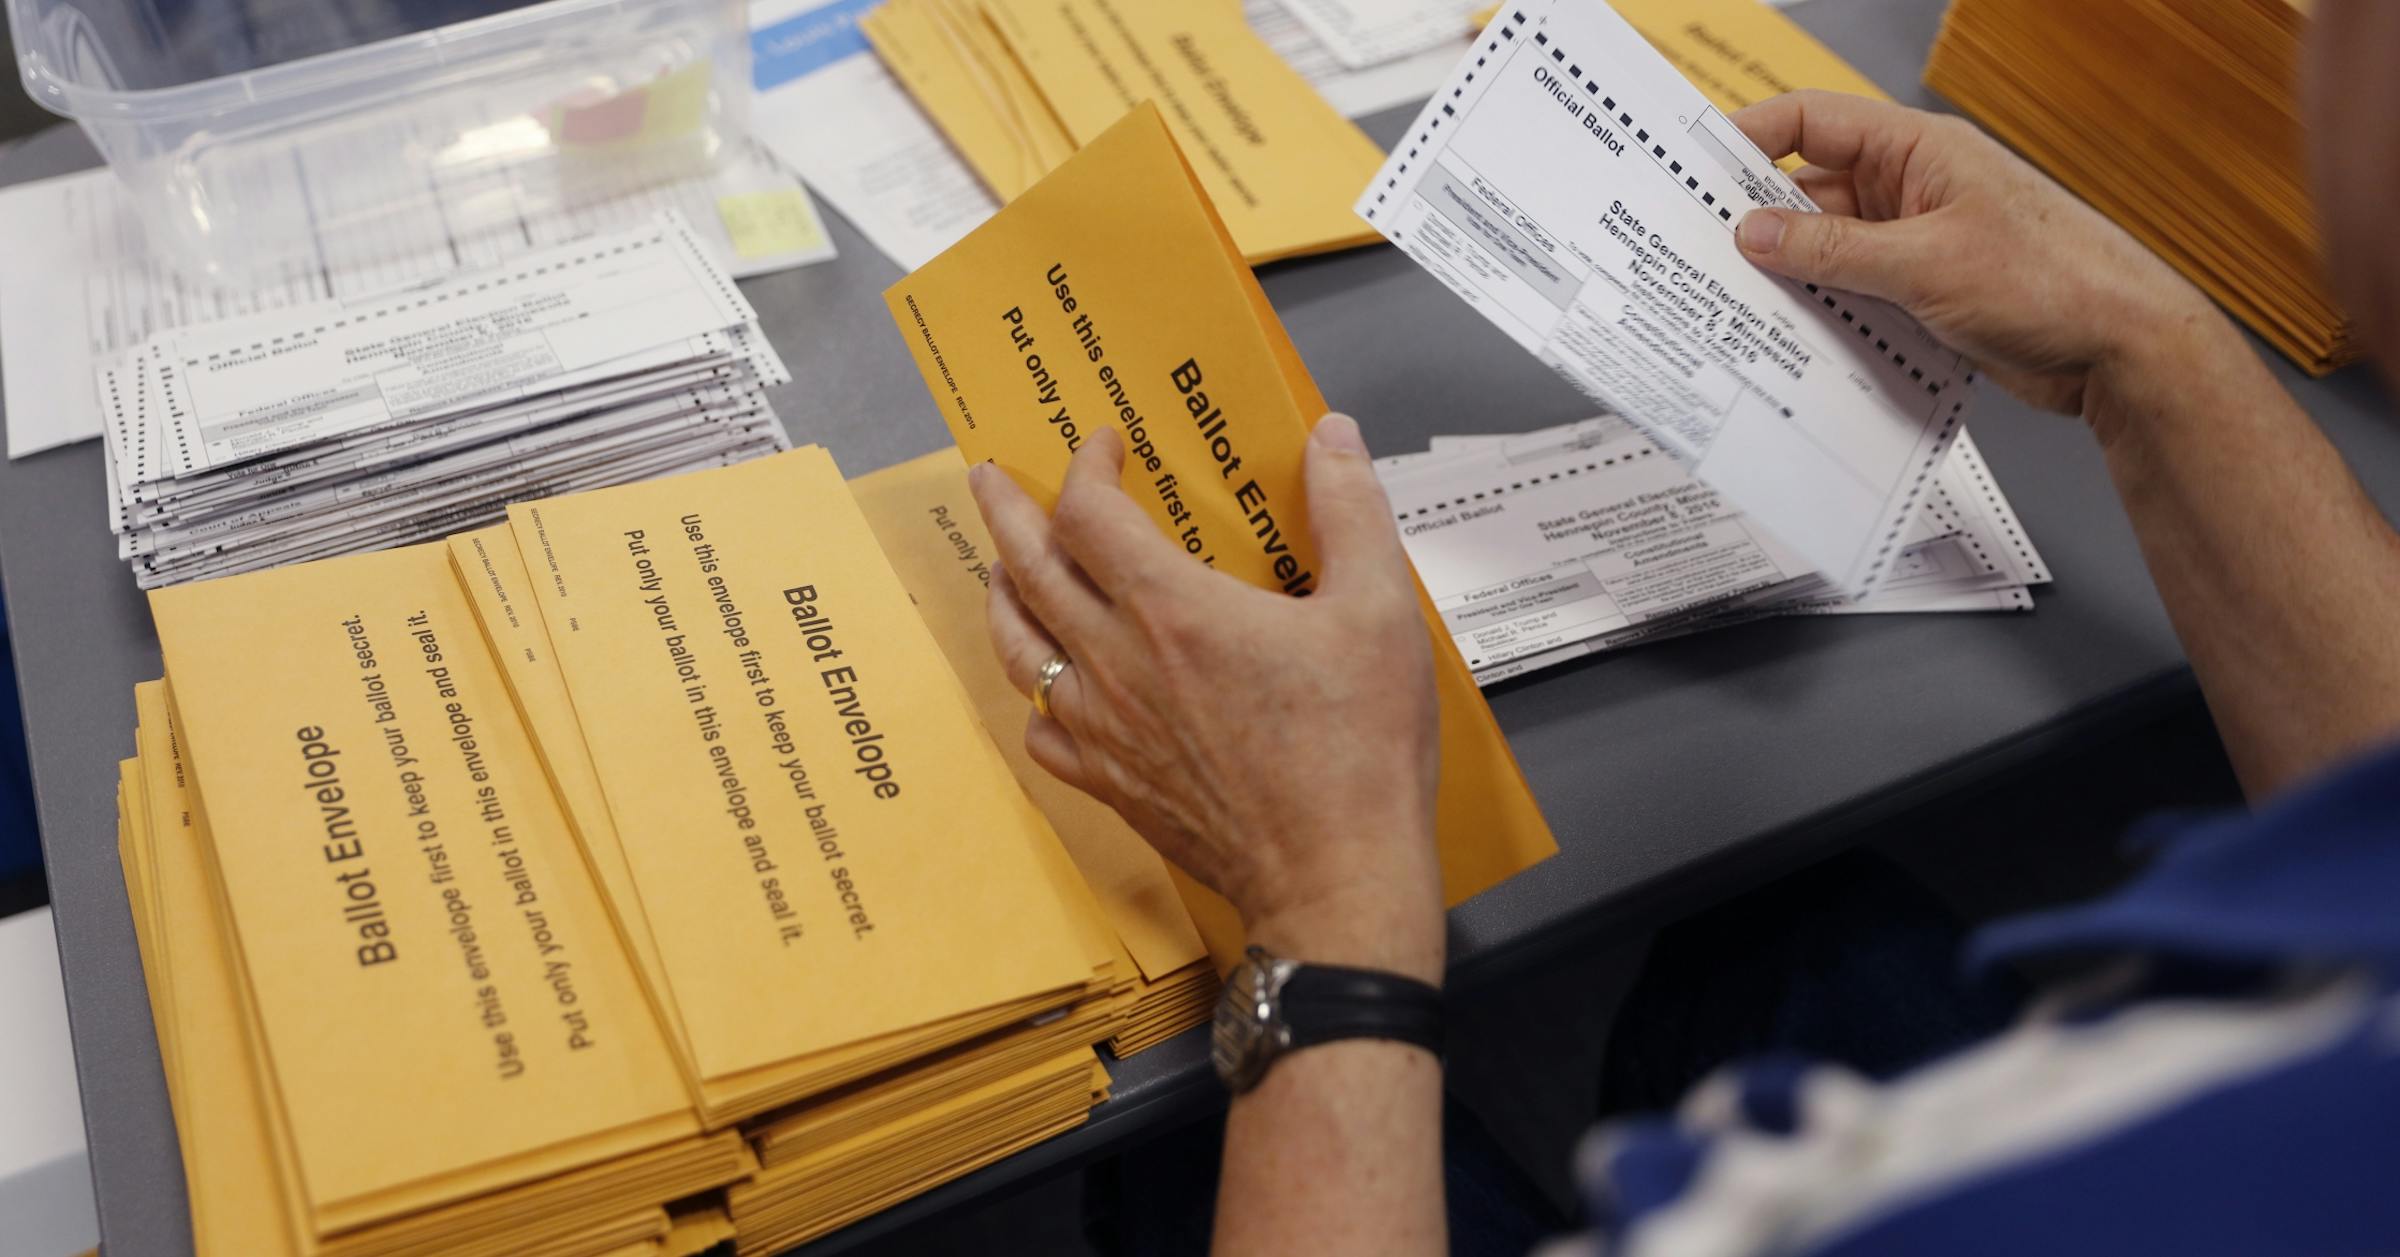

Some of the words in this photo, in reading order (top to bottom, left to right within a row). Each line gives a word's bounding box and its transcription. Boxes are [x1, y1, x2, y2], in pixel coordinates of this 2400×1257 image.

[1533, 66, 1585, 118] Official
[1582, 112, 1625, 157] Ballot
[1742, 168, 1754, 182] One
[1746, 184, 1768, 206] Judge
[1764, 175, 1787, 201] Garcia
[1471, 177, 1515, 218] Federal
[1515, 215, 1555, 253] Offices
[1764, 189, 1776, 204] Vote
[1599, 213, 1666, 274] Hennepin
[1671, 272, 1723, 321] County,
[1729, 317, 1802, 378] Minnesota
[1610, 201, 1645, 236] State
[1649, 234, 1705, 283] General
[1706, 280, 1765, 330] Election
[1768, 327, 1810, 364] Ballot
[1629, 260, 1703, 320] November
[1722, 332, 1756, 363] 2016
[209, 351, 267, 372] Official
[271, 339, 318, 356] Ballot
[906, 295, 926, 327] SECRECY
[923, 328, 939, 355] BALLOT
[936, 355, 957, 393] ENVELOPE
[1001, 305, 1035, 353] Put
[1026, 354, 1062, 405] only
[1047, 406, 1081, 455] you
[1046, 262, 1078, 314] Use
[1072, 313, 1104, 363] this
[1098, 365, 1162, 473] envelope
[1154, 473, 1192, 527] first
[1181, 526, 1203, 555] to
[1170, 357, 1242, 481] Ballot
[1234, 479, 1318, 599] Envel
[680, 513, 705, 542] Use
[1403, 515, 1458, 536] Official
[1459, 503, 1504, 522] Ballot
[1537, 516, 1576, 531] State
[1578, 498, 1637, 520] General
[1637, 483, 1698, 505] Election
[623, 529, 651, 557] Put
[928, 505, 957, 531] Put
[947, 531, 979, 561] only
[966, 561, 991, 589] yo
[1543, 518, 1615, 542] Hennepin
[1591, 515, 1666, 541] November
[1623, 532, 1705, 560] Constitutional
[635, 559, 663, 591] only
[693, 543, 720, 574] this
[1633, 541, 1709, 568] Amendments
[1463, 584, 1509, 602] Federal
[1510, 573, 1553, 590] Offices
[407, 610, 429, 628] it.
[645, 594, 678, 631] your
[707, 576, 750, 648] envelope
[1456, 605, 1499, 621] President
[1499, 599, 1517, 610] and
[1472, 626, 1503, 642] Donald
[1511, 617, 1541, 632] Trump
[1541, 611, 1558, 621] and
[341, 614, 377, 669] secret.
[411, 629, 443, 663] seal
[1476, 632, 1509, 647] Michael
[1520, 622, 1549, 633] Pence
[1487, 650, 1515, 665] Hillary
[1514, 641, 1545, 654] Clinton
[1546, 636, 1563, 646] and
[665, 634, 701, 684] ballot
[738, 649, 771, 686] first
[1475, 670, 1506, 683] Clinton
[1507, 663, 1524, 674] and
[361, 673, 397, 724] ballot
[425, 666, 457, 699] and
[685, 684, 707, 704] in
[755, 687, 775, 707] to
[782, 584, 843, 663] Ballot
[820, 665, 901, 800] Envelope
[445, 702, 489, 783] envelope
[693, 705, 722, 742] this
[764, 709, 796, 755] keep
[383, 727, 419, 768] your
[296, 725, 364, 864] Envelope
[399, 771, 430, 817] keep
[709, 745, 756, 830] envelope
[778, 757, 817, 800] your
[475, 786, 505, 823] this
[417, 820, 439, 841] to
[491, 825, 514, 846] in
[804, 804, 845, 862] ballot
[421, 843, 455, 885] first
[743, 834, 778, 874] and
[497, 848, 538, 906] ballot
[335, 868, 398, 967] Ballot
[760, 877, 797, 921] seal
[830, 866, 875, 940] secret.
[441, 887, 490, 981] envelope
[524, 910, 562, 956] your
[779, 923, 804, 947] it.
[543, 961, 578, 1006] only
[476, 985, 507, 1029] this
[561, 1009, 594, 1051] Put
[494, 1032, 525, 1079] Use
